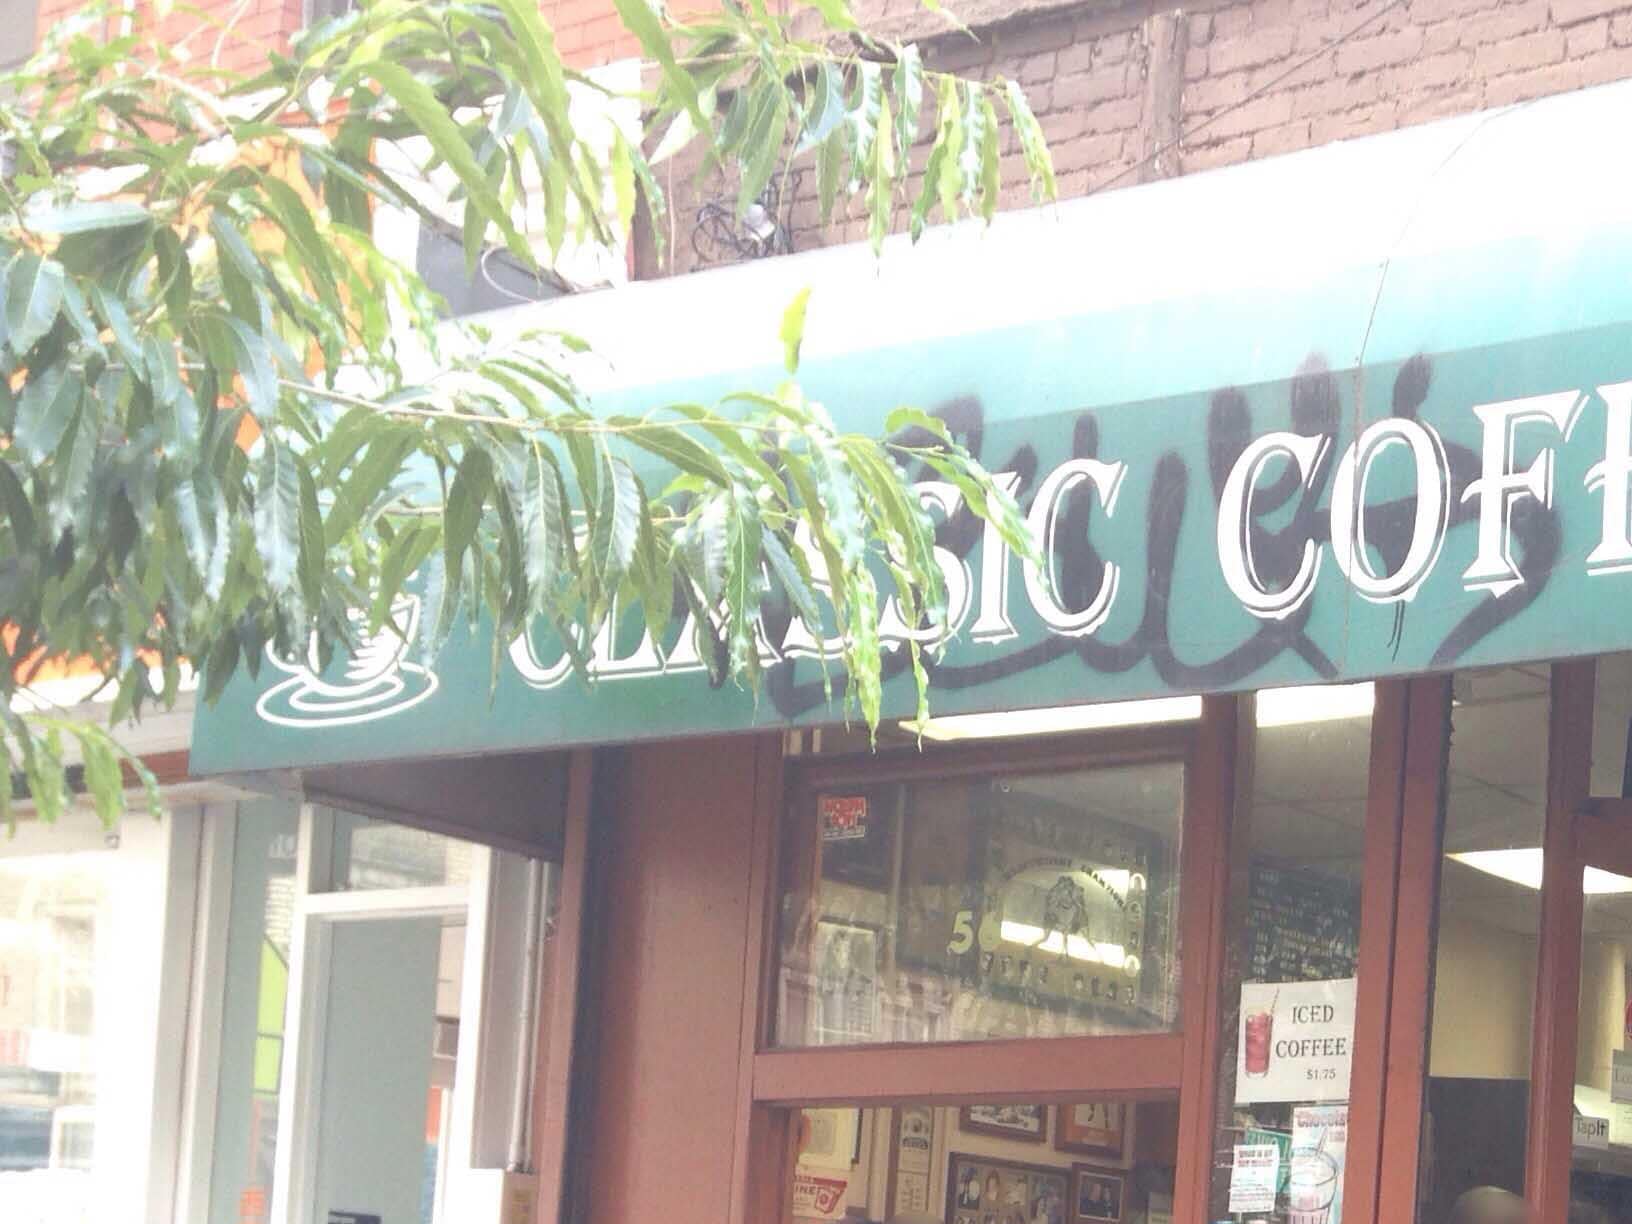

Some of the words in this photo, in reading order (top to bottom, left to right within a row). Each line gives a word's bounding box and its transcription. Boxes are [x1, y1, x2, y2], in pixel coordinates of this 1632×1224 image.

[1291, 1004, 1334, 1024] ICED
[1275, 1037, 1347, 1058] COFFEE
[1306, 1069, 1336, 1080] $1.75
